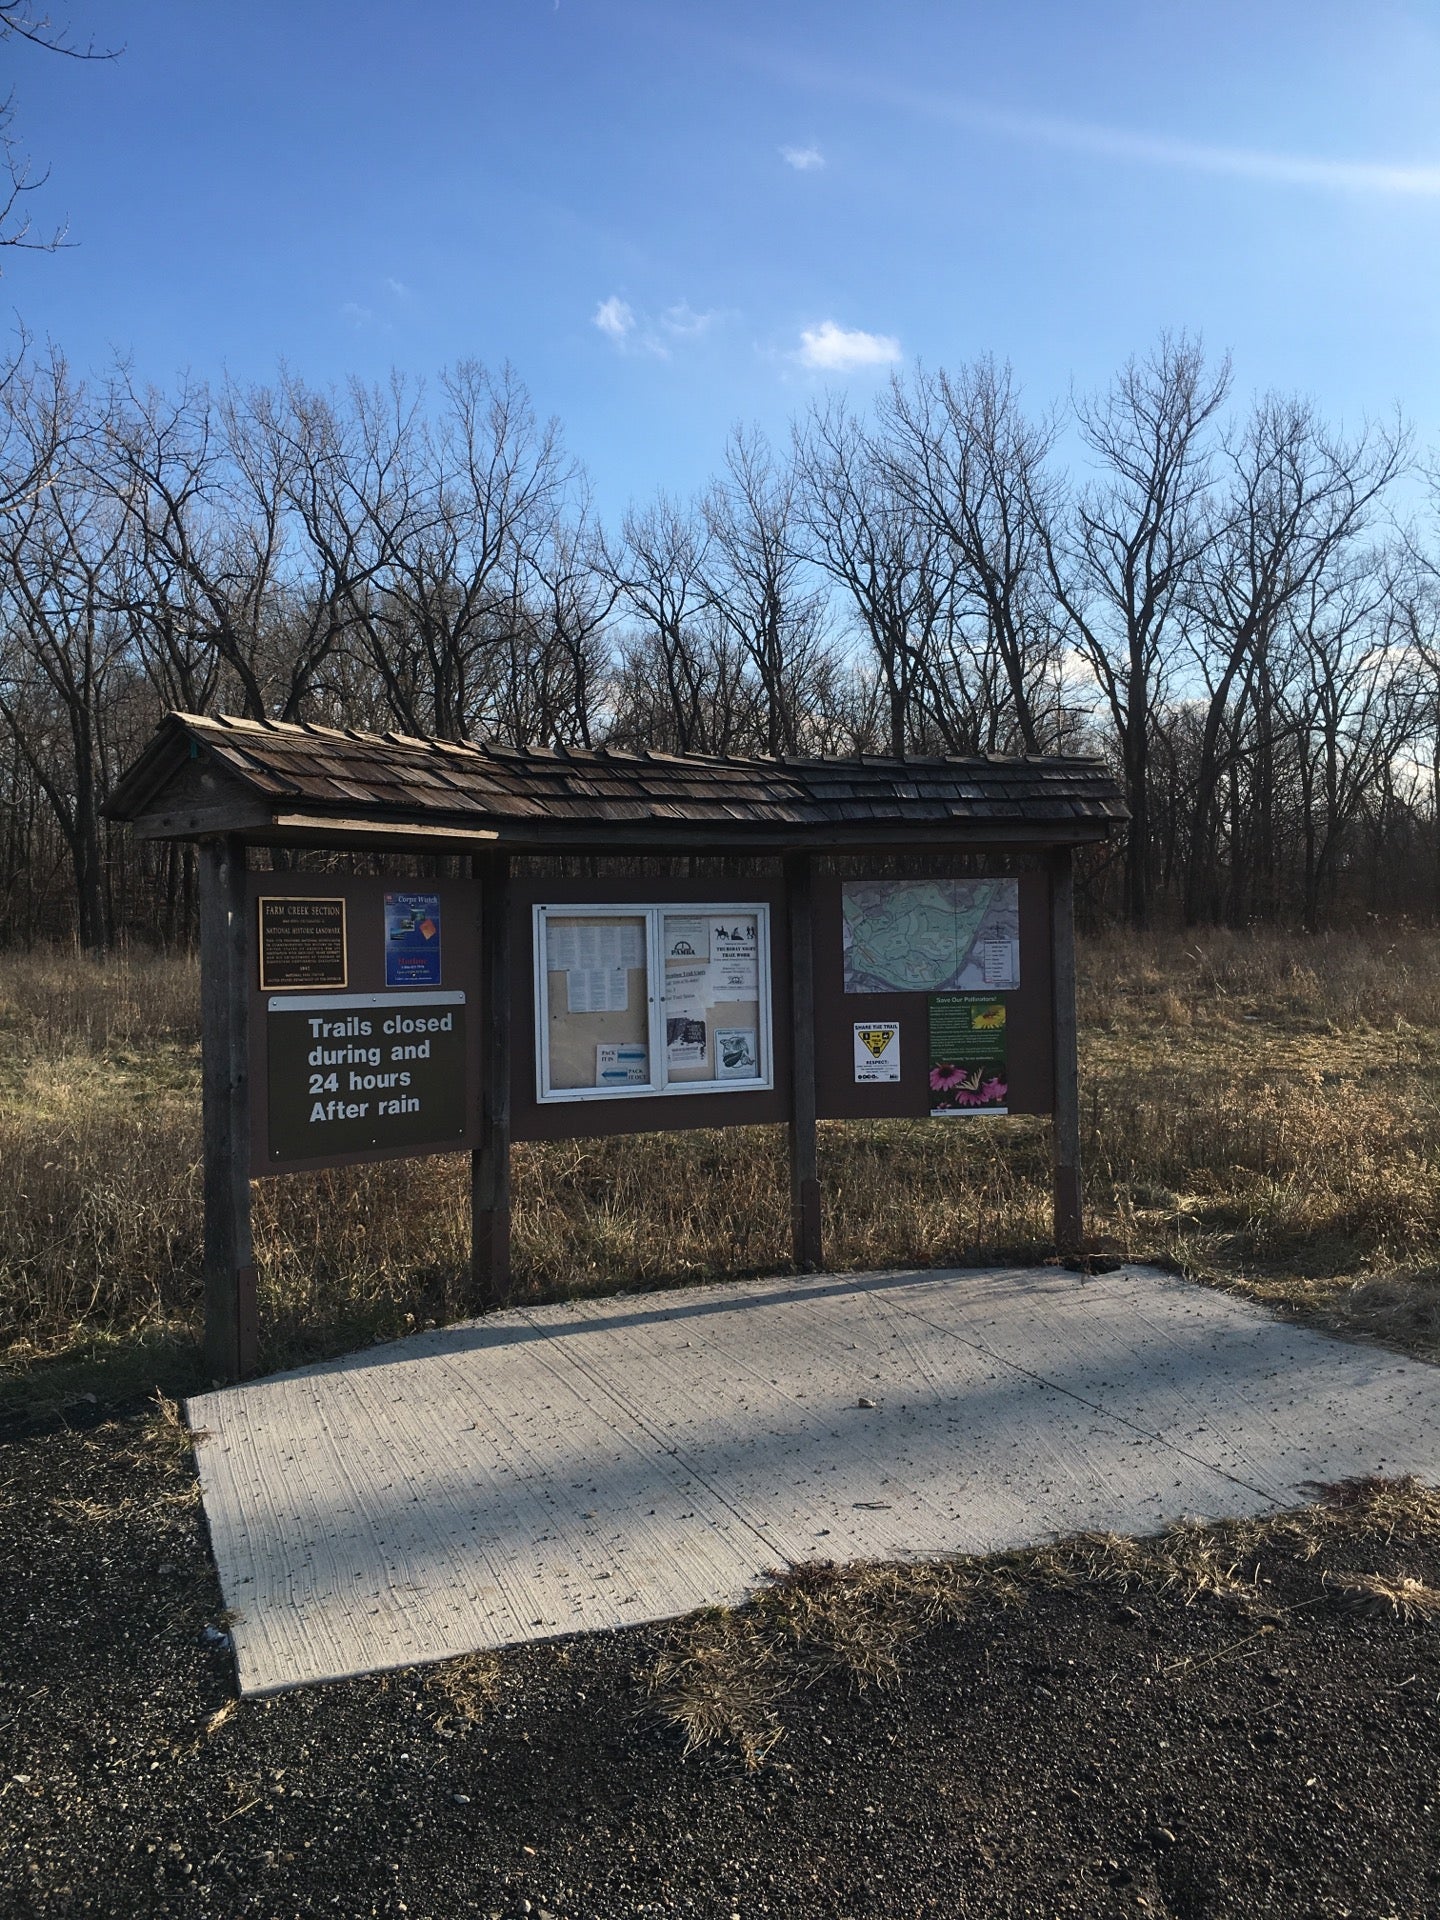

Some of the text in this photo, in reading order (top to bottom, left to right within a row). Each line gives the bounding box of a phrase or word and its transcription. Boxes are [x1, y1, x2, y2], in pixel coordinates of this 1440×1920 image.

[266, 906, 340, 916] FARM CREEK SECTION
[398, 896, 438, 905] Corps Watch
[308, 1012, 454, 1039] Trails closed
[308, 1039, 431, 1067] during and
[308, 1070, 412, 1094] 24 hours
[309, 1094, 420, 1122] After rain
